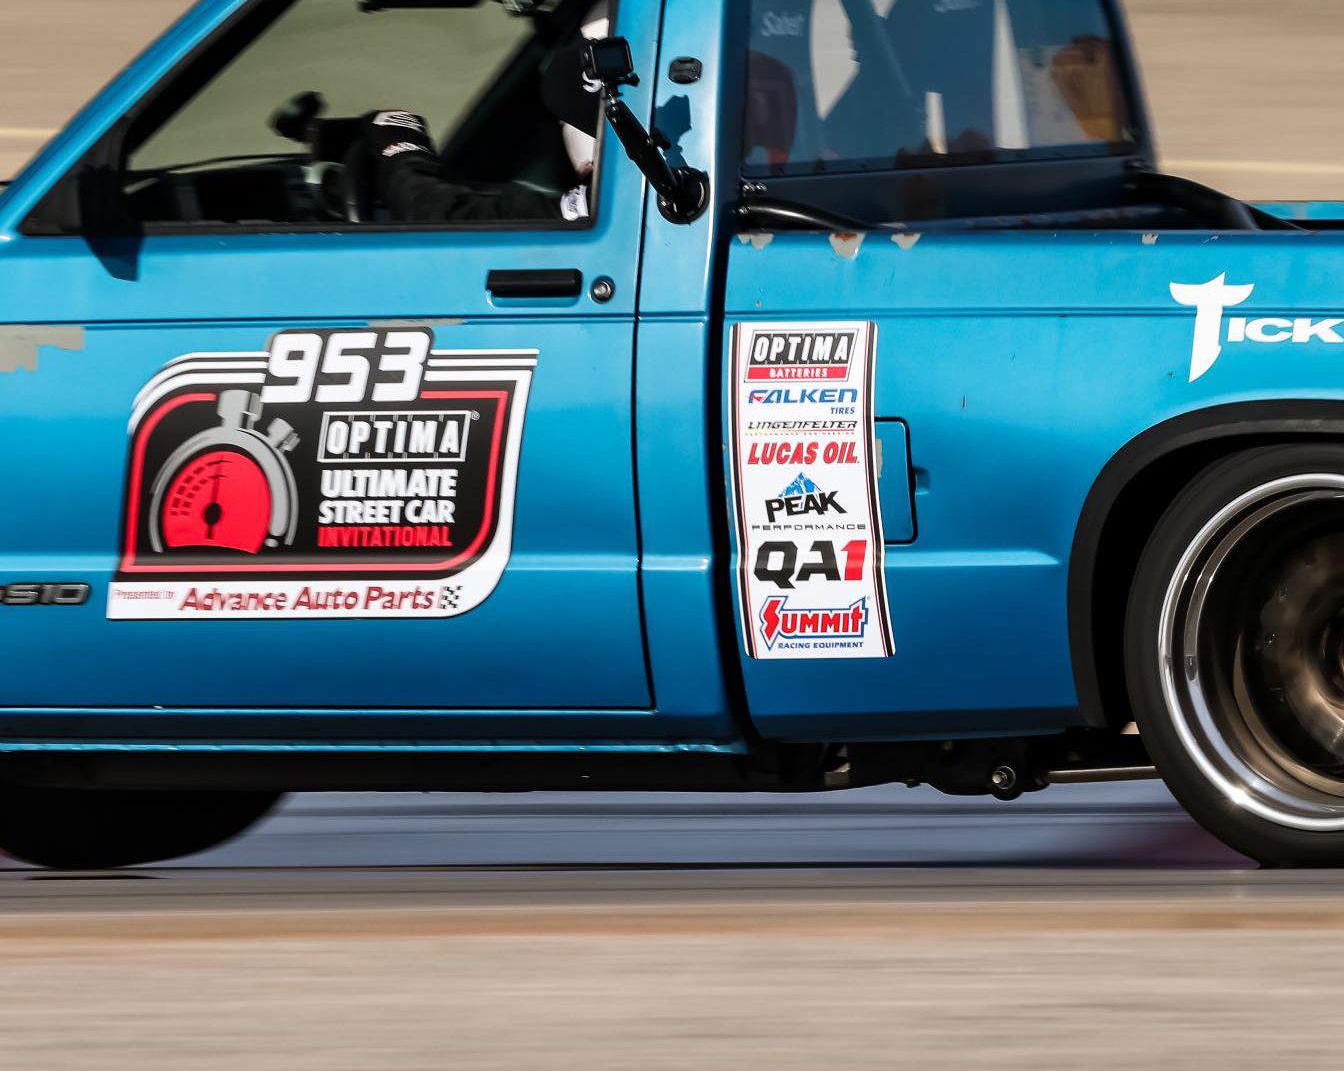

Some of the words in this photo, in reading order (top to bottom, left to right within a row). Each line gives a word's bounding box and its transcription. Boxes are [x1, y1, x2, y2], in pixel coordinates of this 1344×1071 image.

[753, 335, 850, 362] OPTIMA
[259, 330, 431, 403] 953
[769, 367, 828, 378] BATTERIES
[747, 388, 858, 404] FALKEN
[830, 407, 855, 415] TIRES
[747, 420, 858, 429] LINGENFELTER
[325, 420, 460, 455] OPTIMA
[747, 441, 819, 465] LUCAS
[823, 441, 858, 465] OIL
[320, 468, 459, 499] ULTIMATE
[318, 500, 405, 525] STREET
[404, 499, 456, 524] CAR
[765, 491, 848, 523] PEAK
[317, 525, 454, 548] INVITATIONAL
[751, 523, 867, 531] PERFORMANCE
[753, 539, 868, 589] QA1
[178, 587, 288, 611] Advance
[292, 586, 359, 610] Auto
[363, 585, 435, 610] Parts
[813, 641, 864, 649] EQUIPMENT
